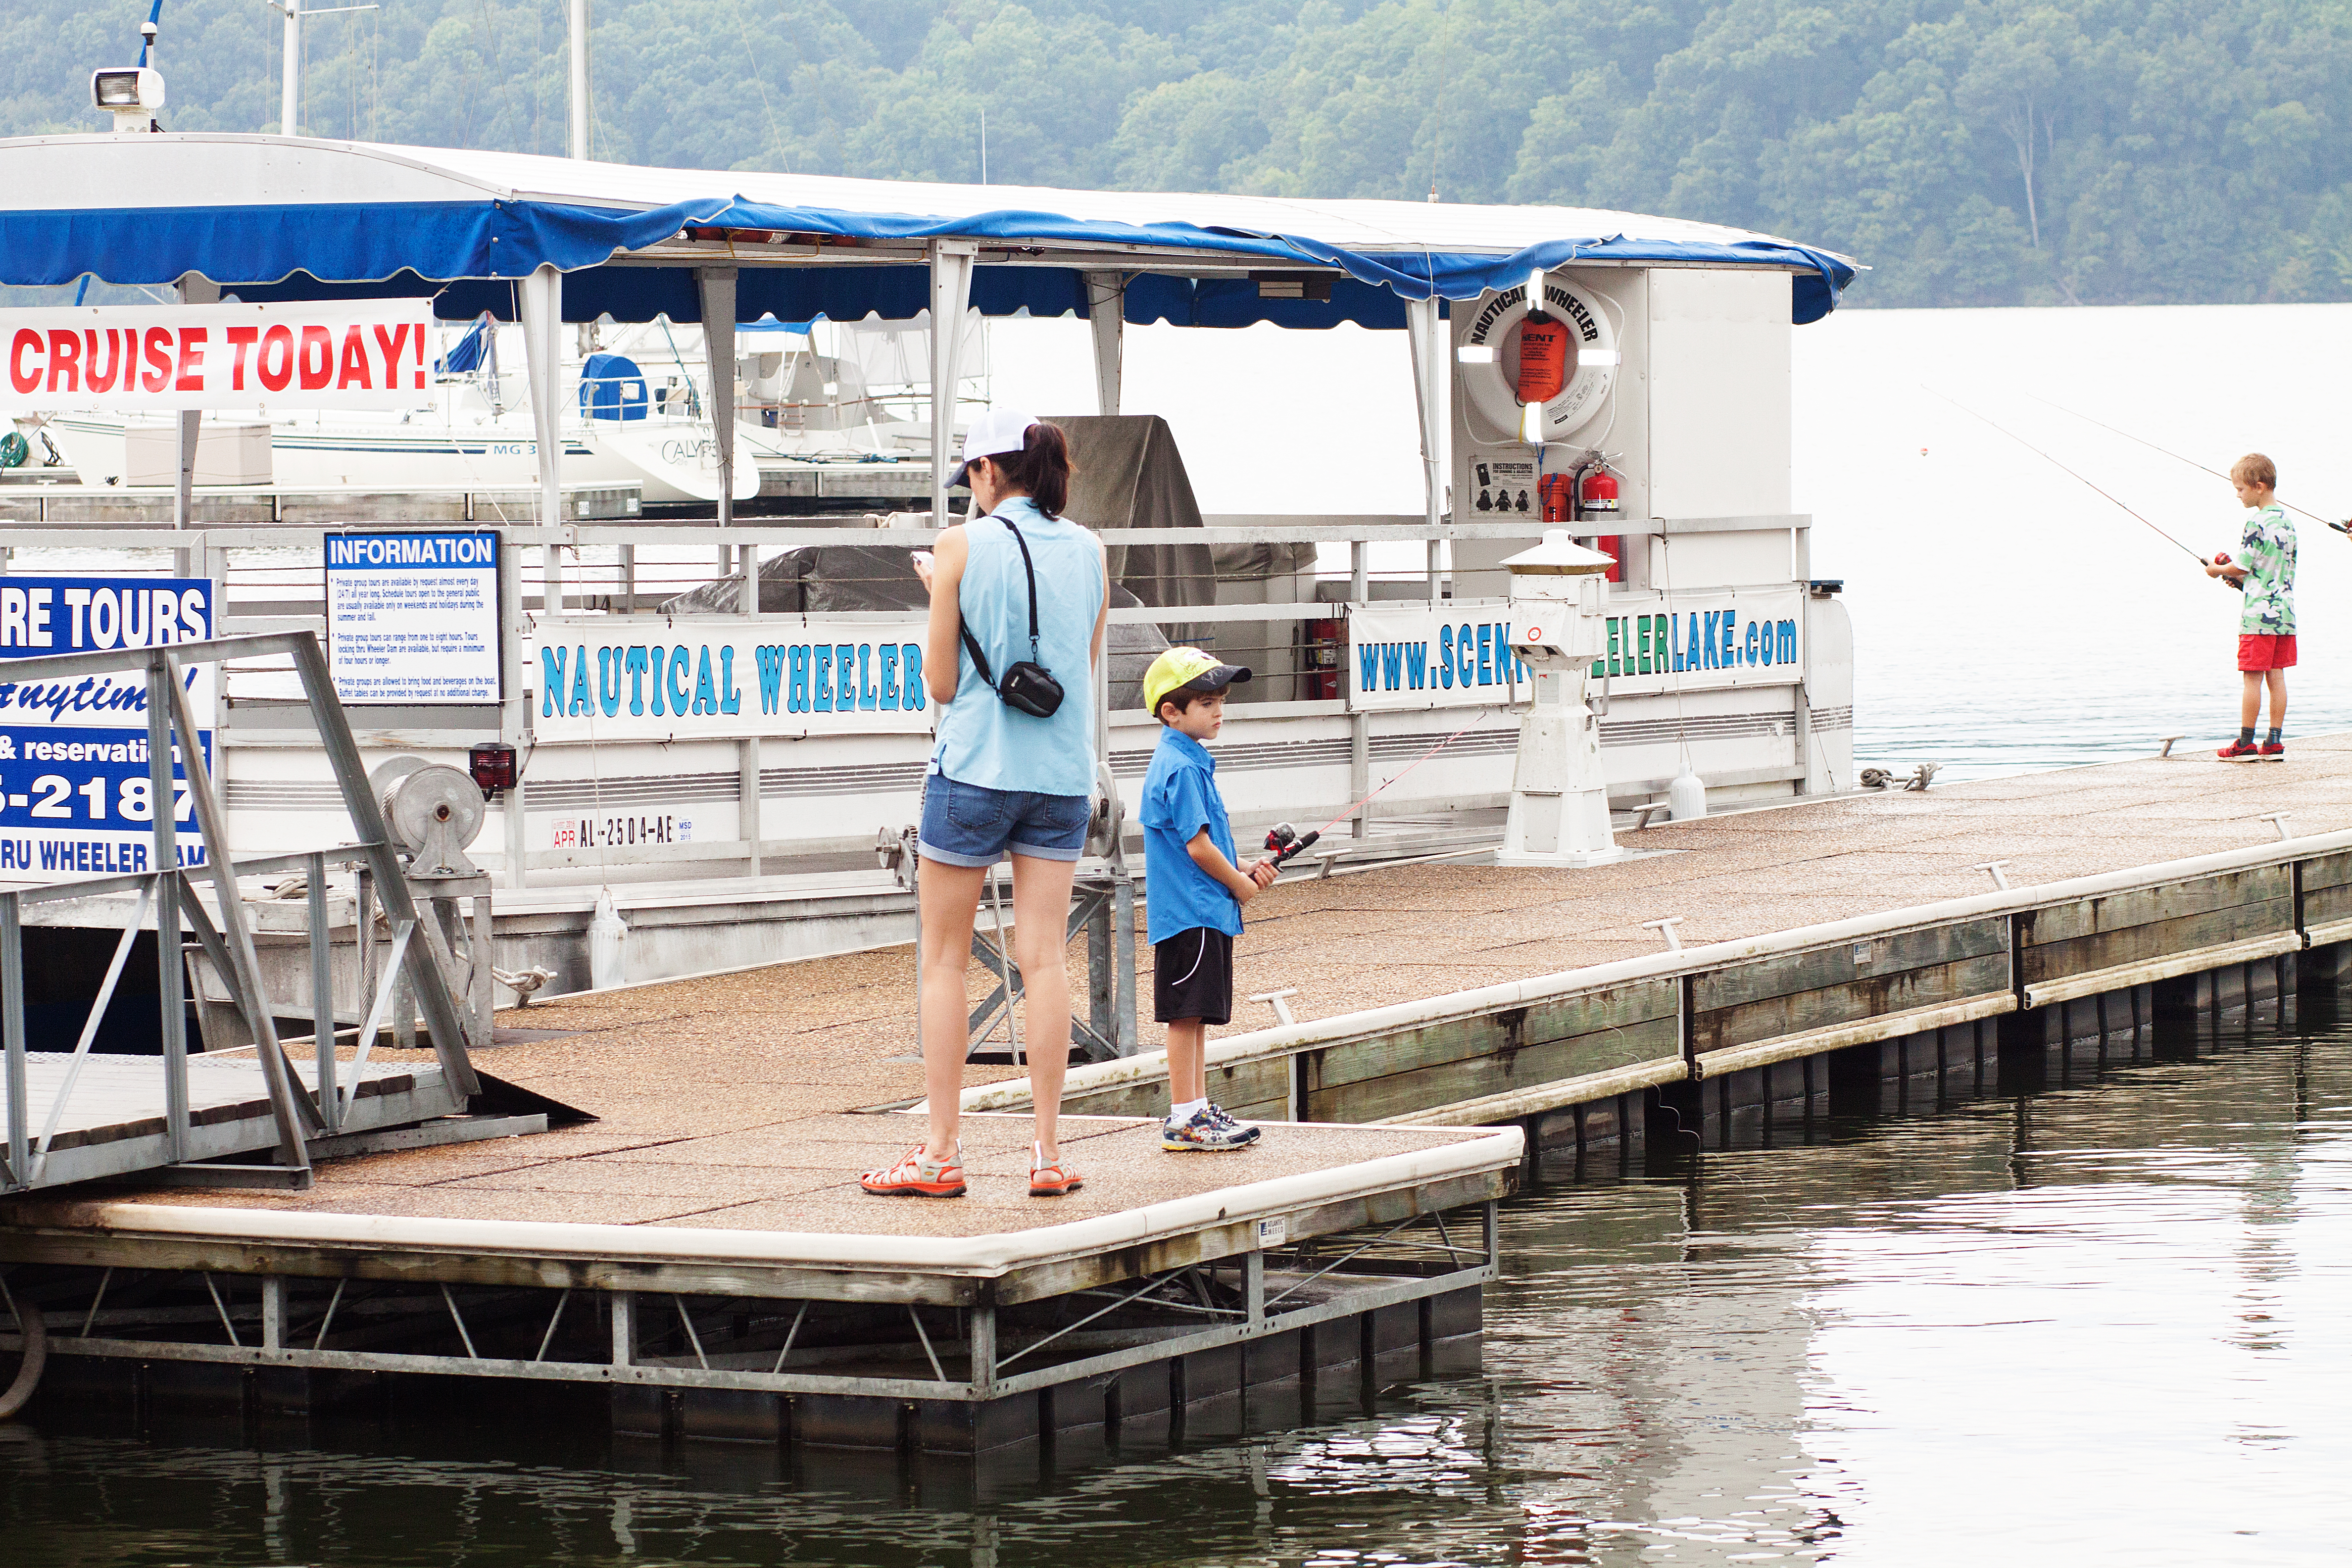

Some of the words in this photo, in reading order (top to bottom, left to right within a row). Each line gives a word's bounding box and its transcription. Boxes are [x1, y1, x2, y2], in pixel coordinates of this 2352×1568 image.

[1470, 286, 1527, 345] NAUTICAL
[1544, 285, 1598, 342] WHEELER
[10, 327, 207, 393] CRUISE
[227, 324, 425, 392] TODAY!
[494, 445, 520, 454] MG
[331, 539, 491, 563] INFORMATION
[336, 578, 352, 586] Private
[354, 579, 367, 588] group
[368, 577, 381, 586] tours
[391, 577, 412, 586] available
[413, 577, 418, 588] by
[420, 577, 438, 588] request
[439, 577, 455, 585] almost
[456, 578, 469, 588] every
[470, 576, 479, 588] day
[358, 590, 368, 599] year
[382, 588, 404, 596] Schedule
[405, 588, 417, 596] tours
[418, 589, 430, 599] open
[431, 588, 436, 596] to
[446, 588, 464, 599] general
[465, 587, 480, 598] public
[345, 601, 362, 612] usually
[363, 600, 385, 609] available
[386, 600, 395, 612] only
[404, 600, 428, 608] weekends
[429, 599, 438, 608] and
[439, 599, 459, 611] holidays
[459, 599, 475, 610] during
[1, 588, 52, 646] RE
[64, 588, 206, 649] TOURS
[357, 612, 366, 621] and
[338, 633, 354, 641] Private
[355, 634, 368, 643] group
[370, 632, 382, 640] tours
[392, 634, 406, 643] range
[407, 632, 418, 640] from
[429, 631, 435, 639] to
[436, 631, 447, 642] eight
[448, 631, 463, 639] hours.
[465, 631, 478, 639] Tours
[338, 644, 355, 655] locking
[356, 644, 366, 652] thru
[367, 644, 386, 652] Wheeler
[387, 644, 397, 652] Dam
[407, 643, 430, 655] available,
[431, 643, 440, 652] but
[440, 643, 457, 655] require
[463, 643, 485, 652] minimum
[338, 656, 343, 664] of
[343, 656, 353, 664] four
[354, 655, 368, 664] hours
[375, 655, 391, 666] longer.
[339, 677, 355, 685] Private
[356, 679, 372, 688] groups
[382, 677, 400, 685] allowed
[401, 677, 406, 685] to
[407, 677, 420, 688] bring
[421, 676, 432, 685] food
[433, 676, 441, 685] and
[442, 676, 467, 687] beverages
[484, 676, 496, 685] boat.
[541, 645, 741, 718] NAUTICAL
[755, 643, 926, 715] WHEELER
[339, 688, 353, 696] Buffet
[354, 688, 369, 696] tables
[379, 688, 386, 696] be
[386, 688, 407, 699] provided
[407, 688, 413, 699] by
[414, 687, 432, 699] request
[434, 687, 439, 696] at
[446, 687, 471, 696] additional
[471, 687, 490, 699] charge.
[0, 735, 17, 759] &
[25, 739, 205, 763] reservatin
[0, 775, 194, 822] -2187
[580, 816, 672, 847] AL-2504-AE
[554, 831, 575, 848] APR
[39, 840, 147, 872] WHEELER
[1268, 1218, 1284, 1227] ATLANTIC
[1268, 1226, 1283, 1235] MEECO
